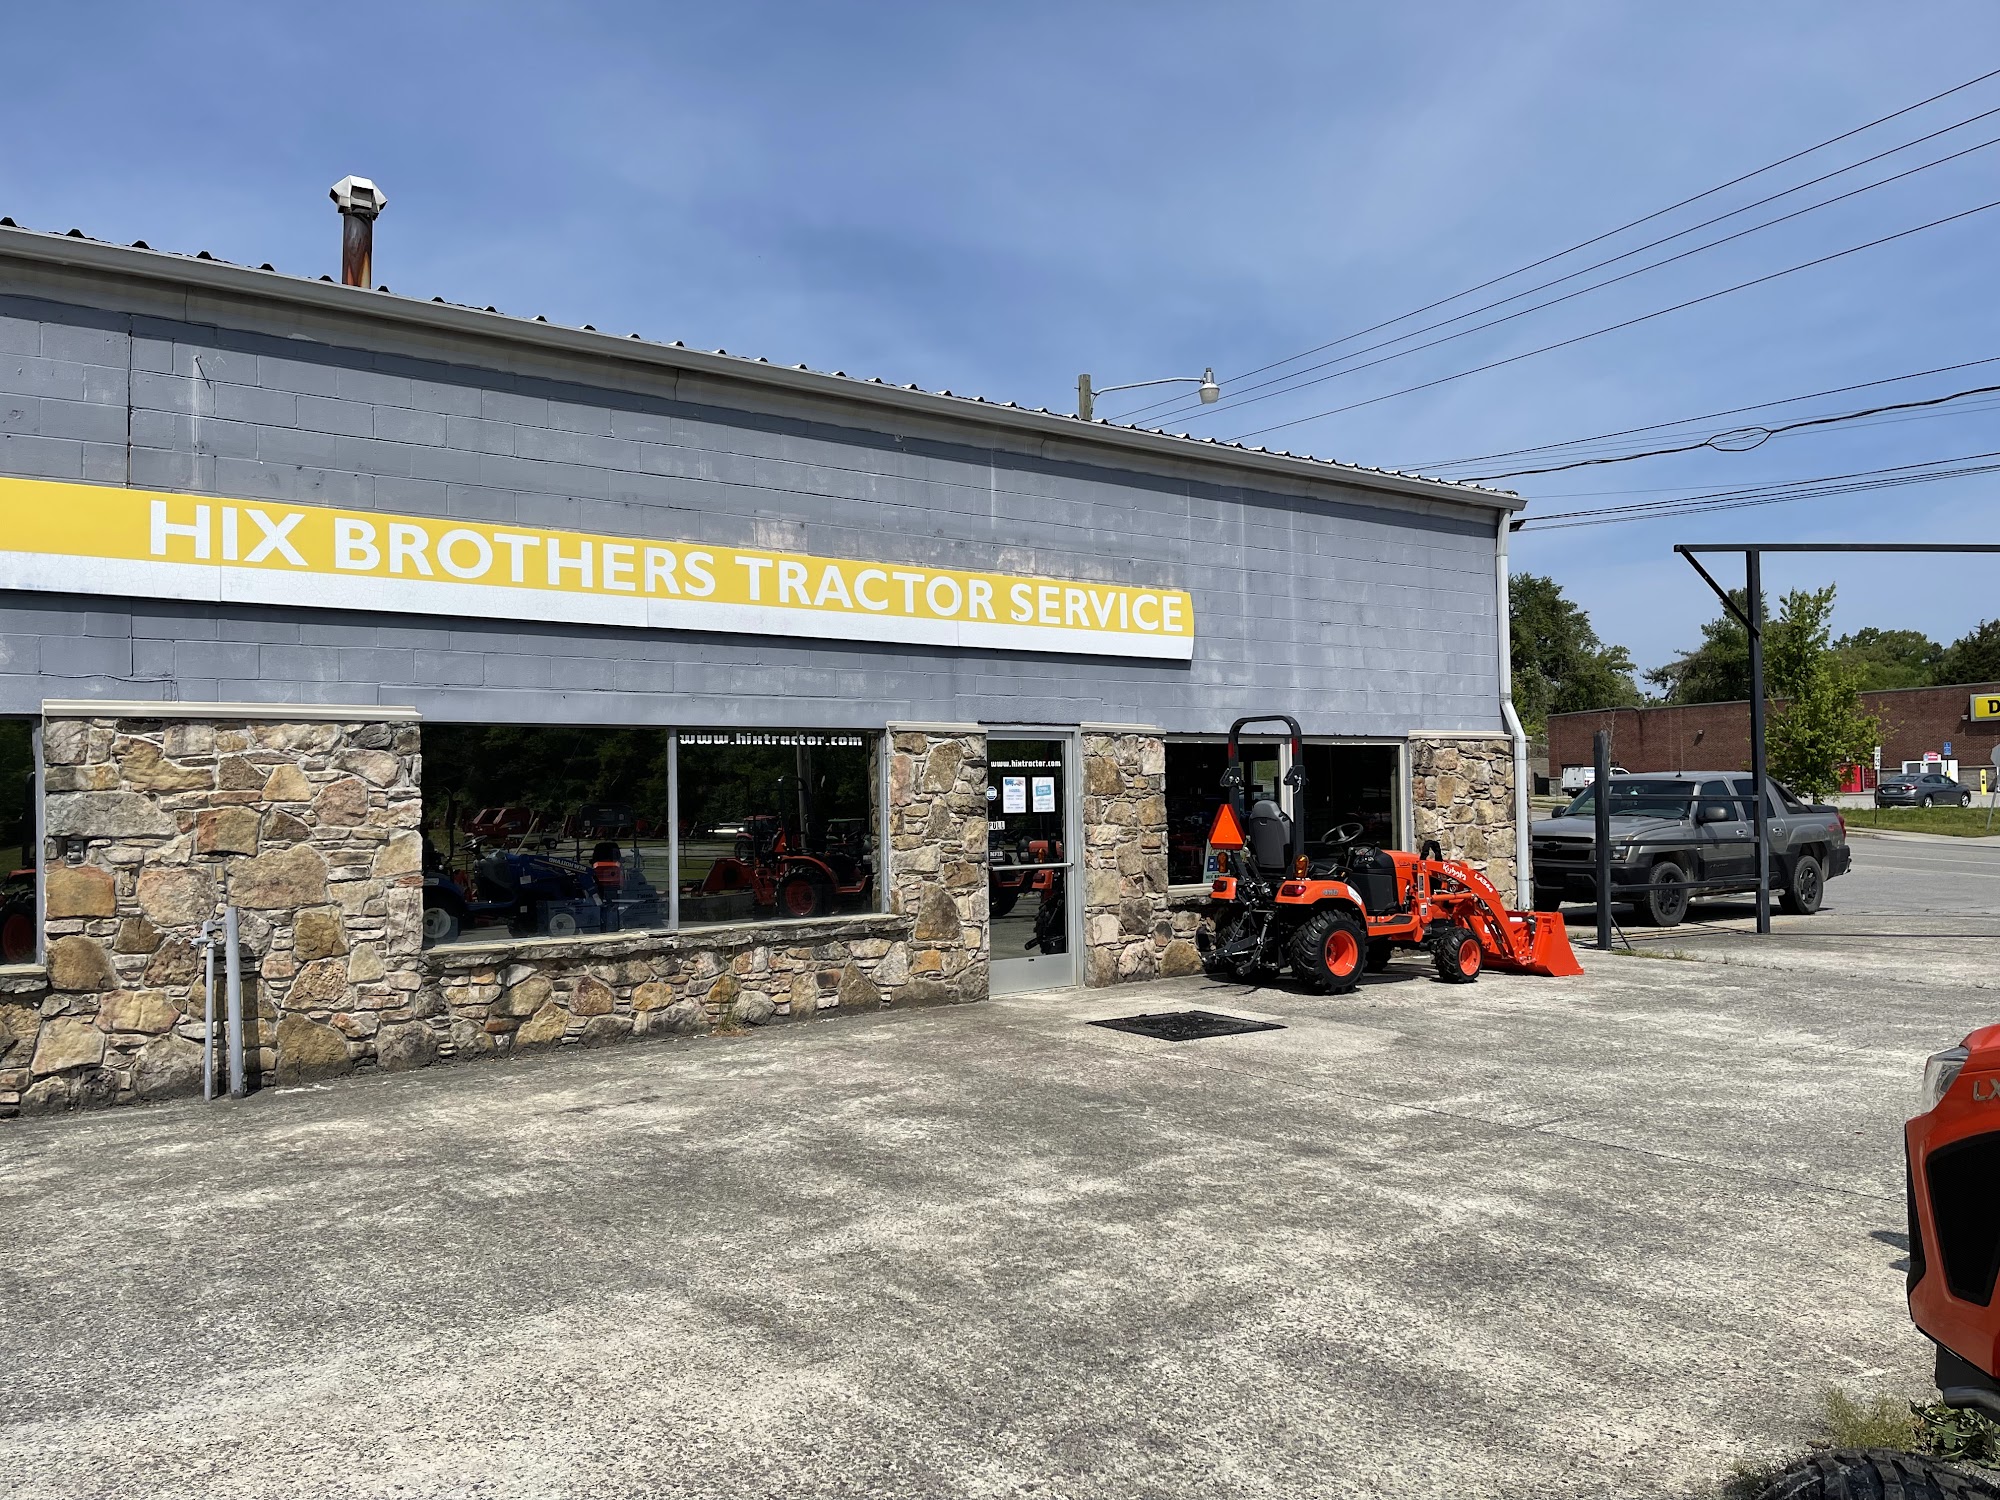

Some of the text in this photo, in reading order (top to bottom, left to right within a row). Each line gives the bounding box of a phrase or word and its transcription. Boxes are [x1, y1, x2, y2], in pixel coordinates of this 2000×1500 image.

[149, 499, 1184, 632] HIX BROTHERS TRACTOR SERVICE
[679, 732, 863, 746] www.hixtractor.com
[988, 822, 1005, 830] PULL
[1442, 862, 1467, 881] Kubota
